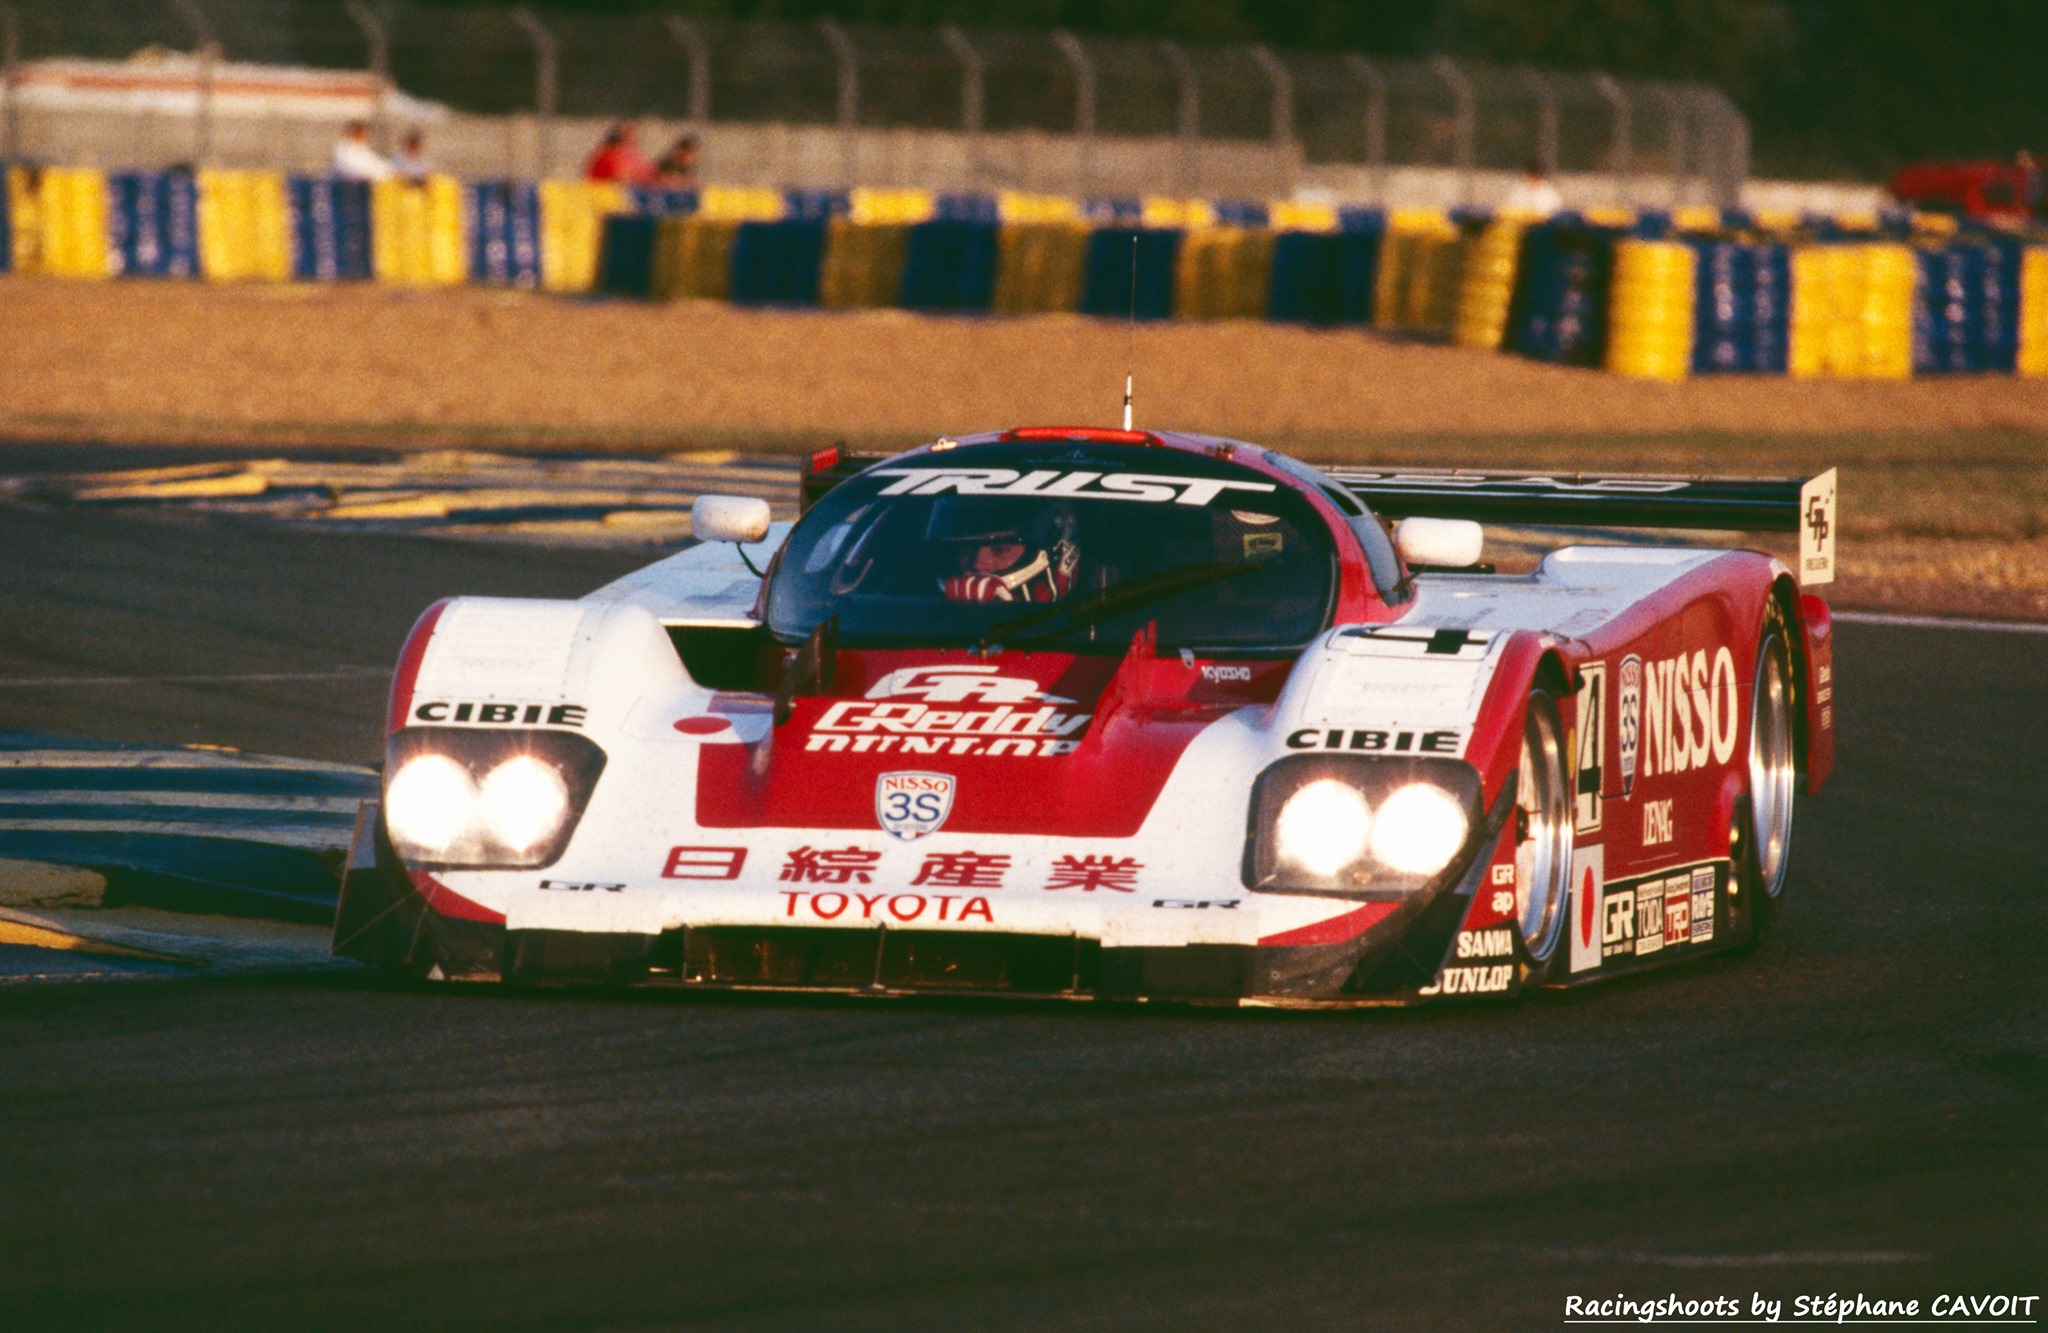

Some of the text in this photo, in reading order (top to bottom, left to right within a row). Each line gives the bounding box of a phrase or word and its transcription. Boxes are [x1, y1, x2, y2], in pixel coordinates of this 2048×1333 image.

[866, 467, 1277, 506] TRUST
[813, 701, 1092, 736] GReddy
[1644, 646, 1738, 778] NISSO
[886, 777, 949, 793] NISSO
[884, 792, 941, 823] 3S
[660, 845, 1145, 893] 日綜産業
[1492, 863, 1515, 885] GR
[779, 891, 994, 923] TOYOTA
[1602, 890, 1635, 944] GR
[1457, 929, 1513, 958] SANWA
